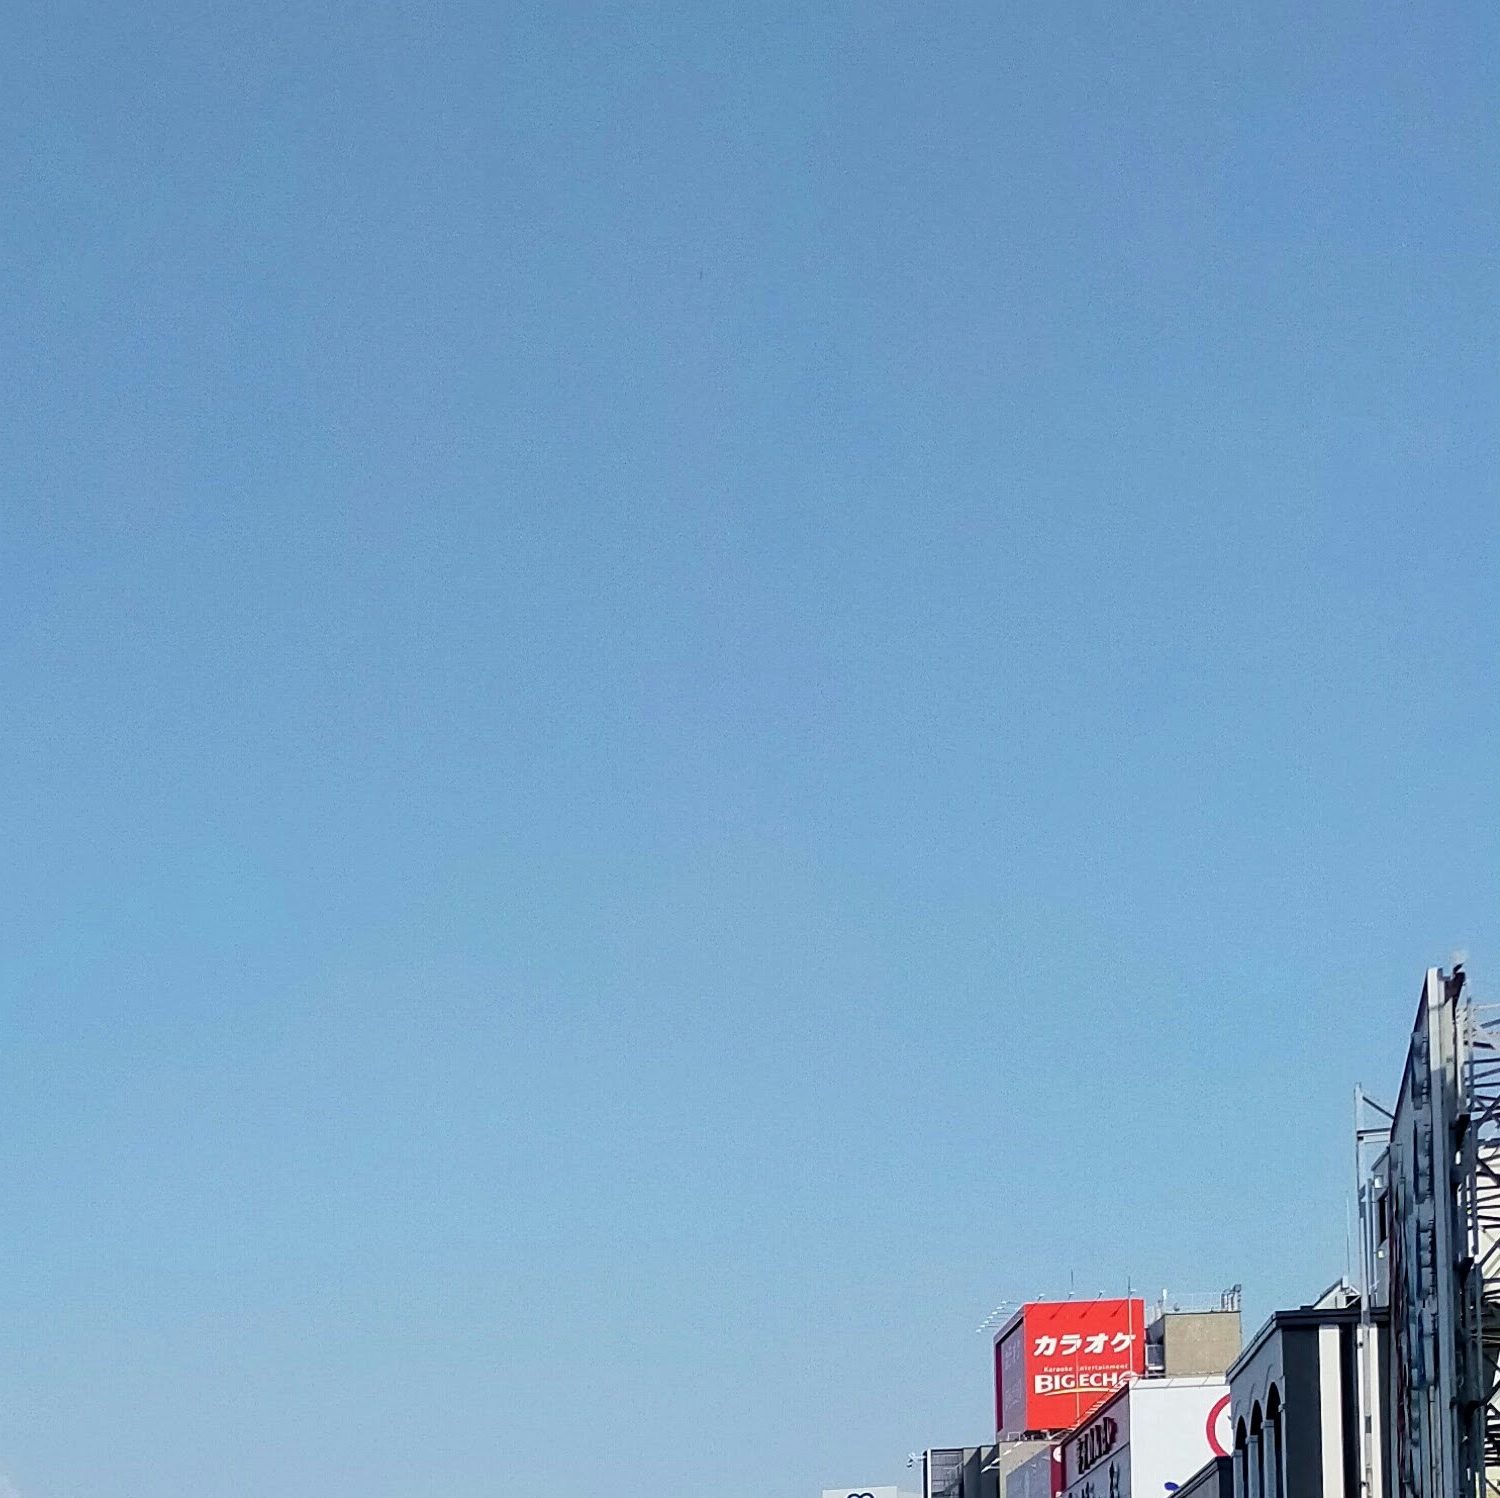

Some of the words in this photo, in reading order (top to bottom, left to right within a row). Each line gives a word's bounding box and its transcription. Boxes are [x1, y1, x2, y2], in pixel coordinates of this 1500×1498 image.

[1033, 1331, 1137, 1357] カラオケ
[1043, 1365, 1073, 1373] Karaoke
[1074, 1363, 1129, 1372] ntertainment
